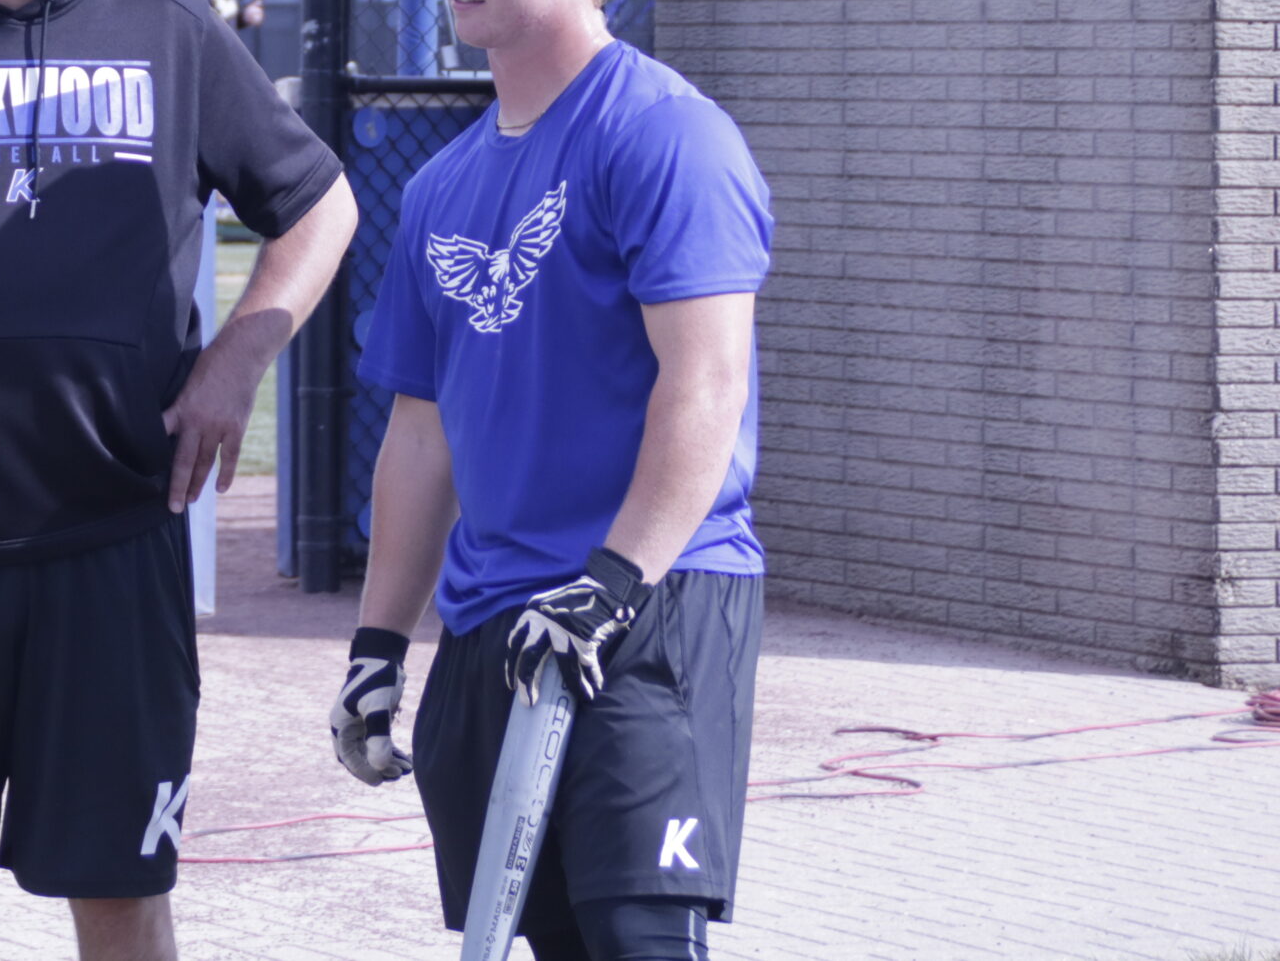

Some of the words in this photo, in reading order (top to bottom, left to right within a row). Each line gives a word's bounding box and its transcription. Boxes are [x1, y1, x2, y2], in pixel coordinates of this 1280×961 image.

[6, 168, 44, 202] K
[140, 774, 190, 855] K
[659, 818, 700, 869] K
